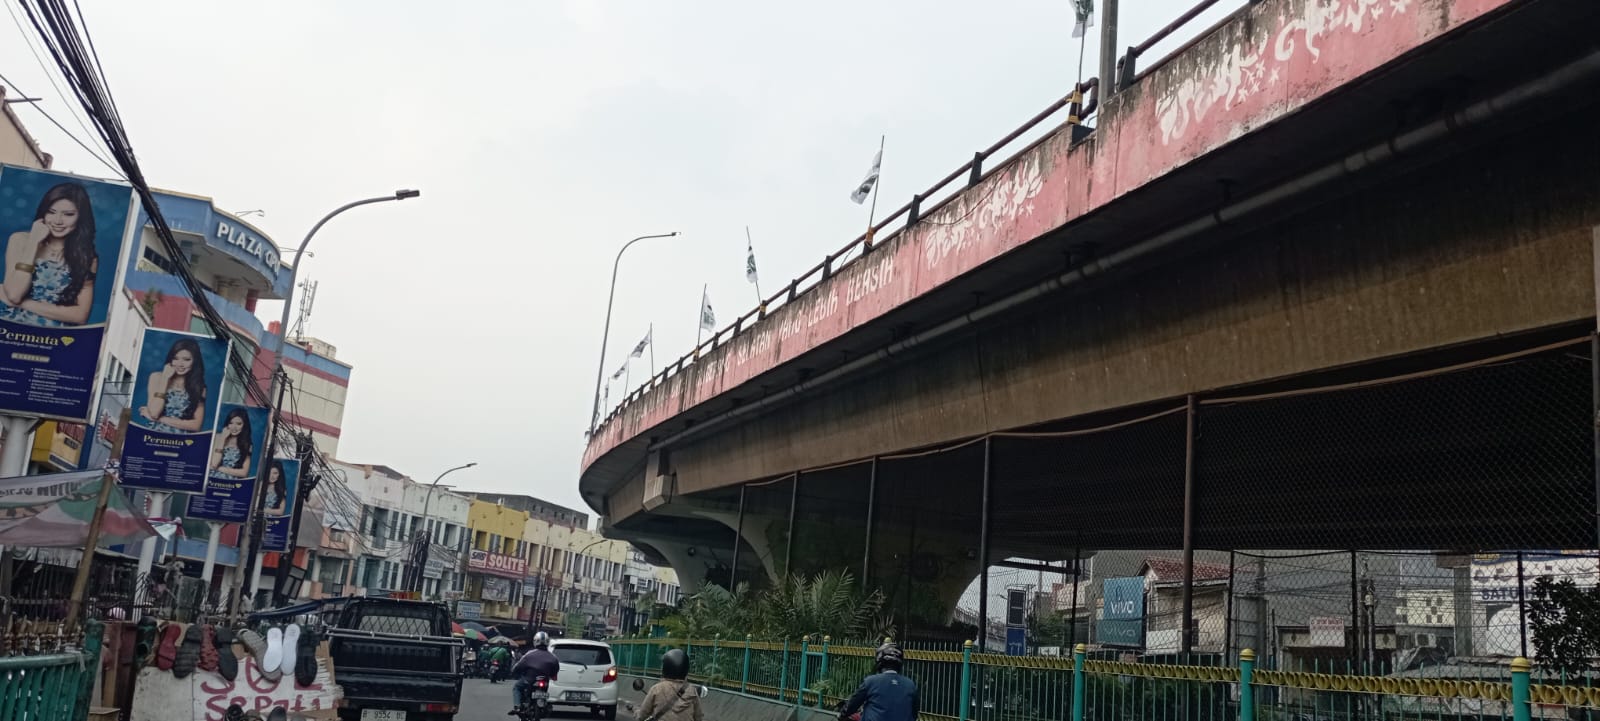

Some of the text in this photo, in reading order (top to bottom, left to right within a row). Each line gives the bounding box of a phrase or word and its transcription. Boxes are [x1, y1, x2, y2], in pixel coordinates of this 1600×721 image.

[216, 222, 263, 259] PLAZA
[0, 327, 60, 347] Permata
[143, 434, 185, 446] Permata
[488, 553, 525, 572] SOLITE
